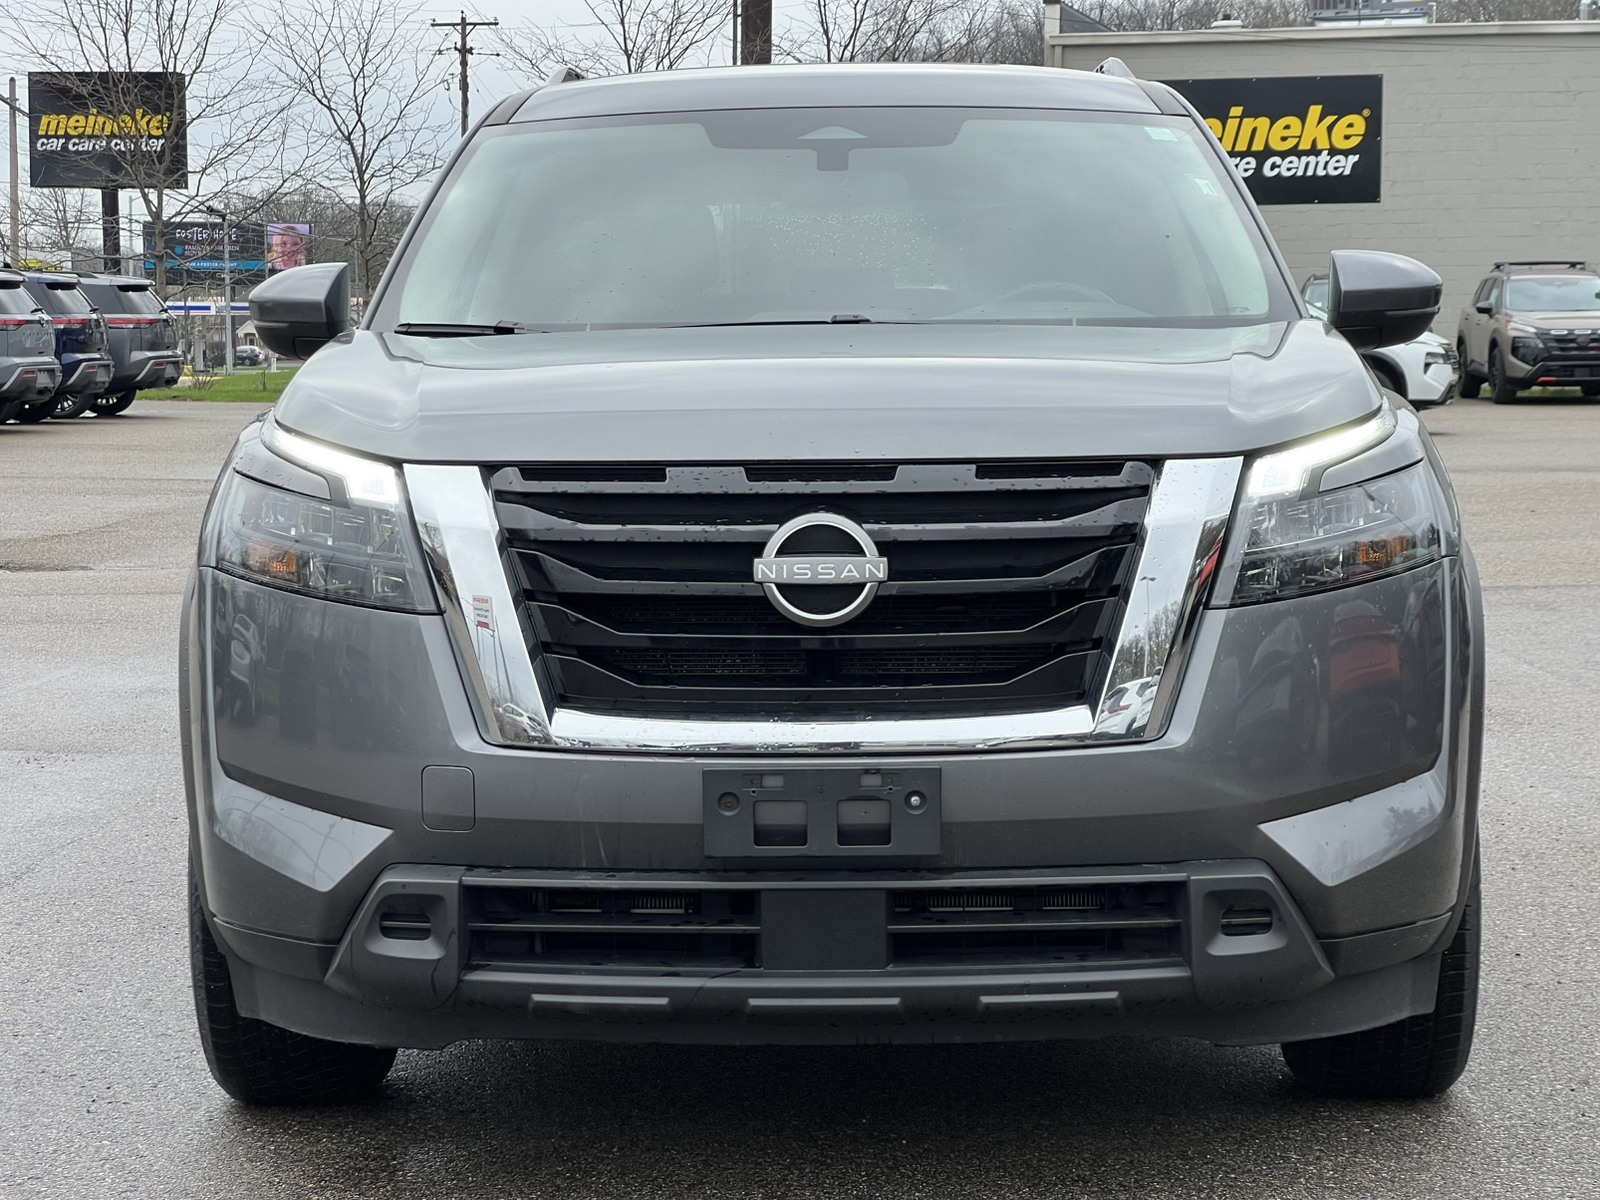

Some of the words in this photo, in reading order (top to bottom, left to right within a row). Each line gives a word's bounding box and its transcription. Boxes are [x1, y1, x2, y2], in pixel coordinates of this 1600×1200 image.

[1204, 105, 1366, 152] ineke
[36, 138, 66, 151] car
[68, 138, 107, 151] care
[1262, 150, 1359, 177] center
[176, 227, 210, 240] FOSTER
[213, 228, 237, 240] HOE
[758, 563, 884, 579] NISSAN
